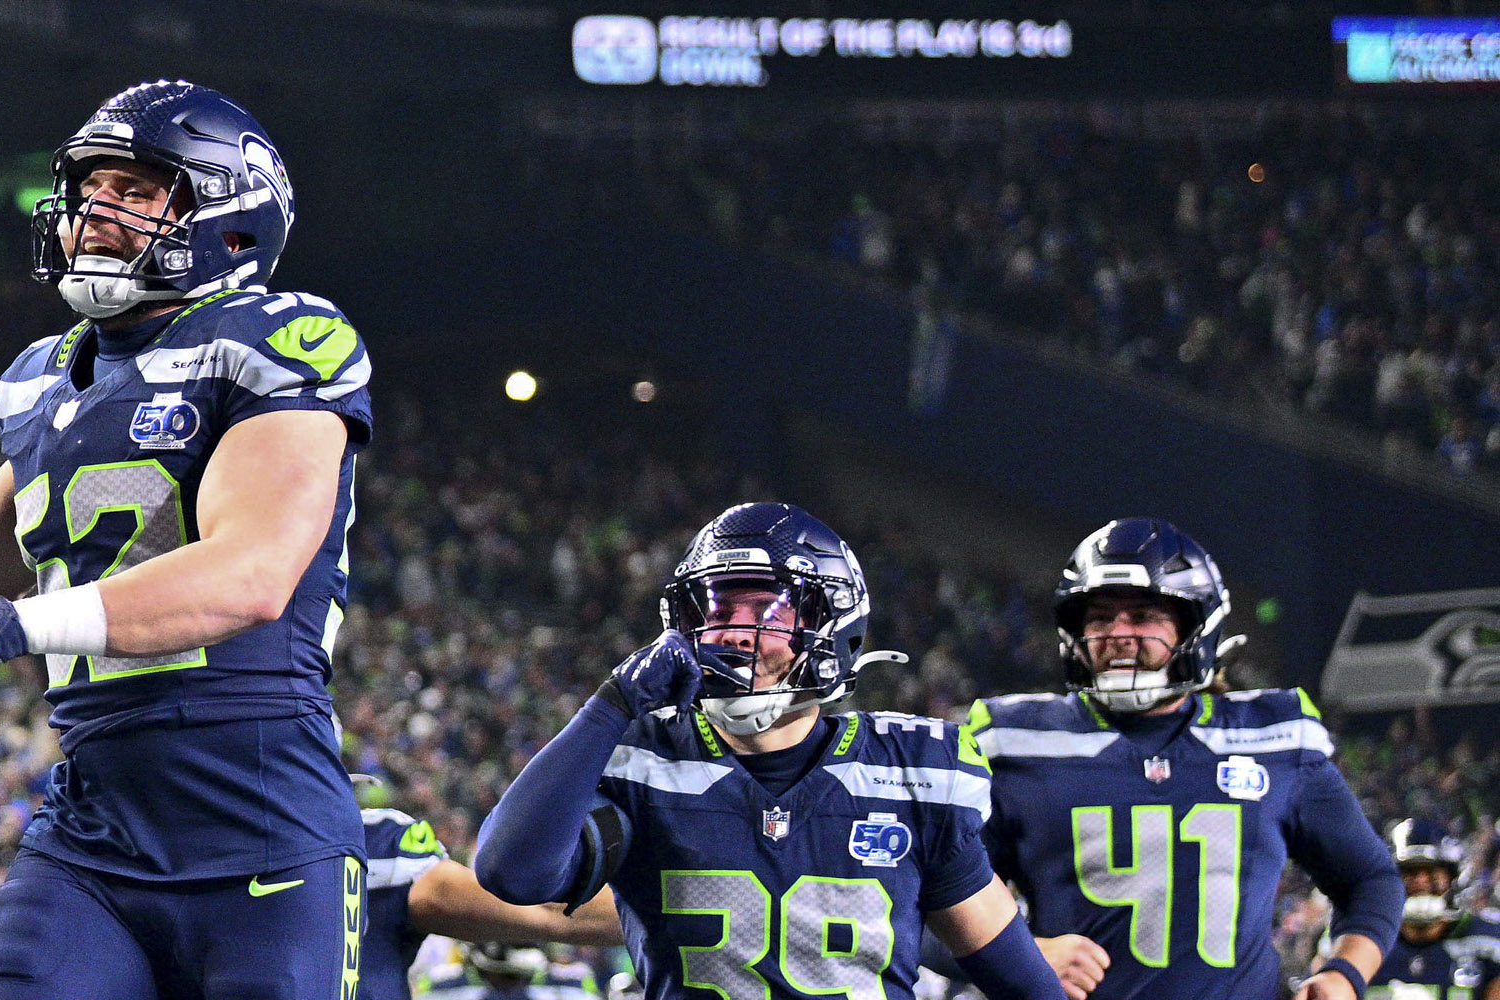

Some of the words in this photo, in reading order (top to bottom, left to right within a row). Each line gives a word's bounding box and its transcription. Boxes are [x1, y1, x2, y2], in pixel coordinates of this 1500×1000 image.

[659, 15, 778, 55] RESULT
[780, 17, 829, 56] OF
[834, 18, 897, 57] THE
[898, 18, 979, 57] PLAY
[980, 18, 1016, 57] IS
[131, 404, 199, 442] 50
[873, 777, 933, 789] SEAHAWKS
[851, 822, 911, 860] 50
[1071, 803, 1242, 968] 41
